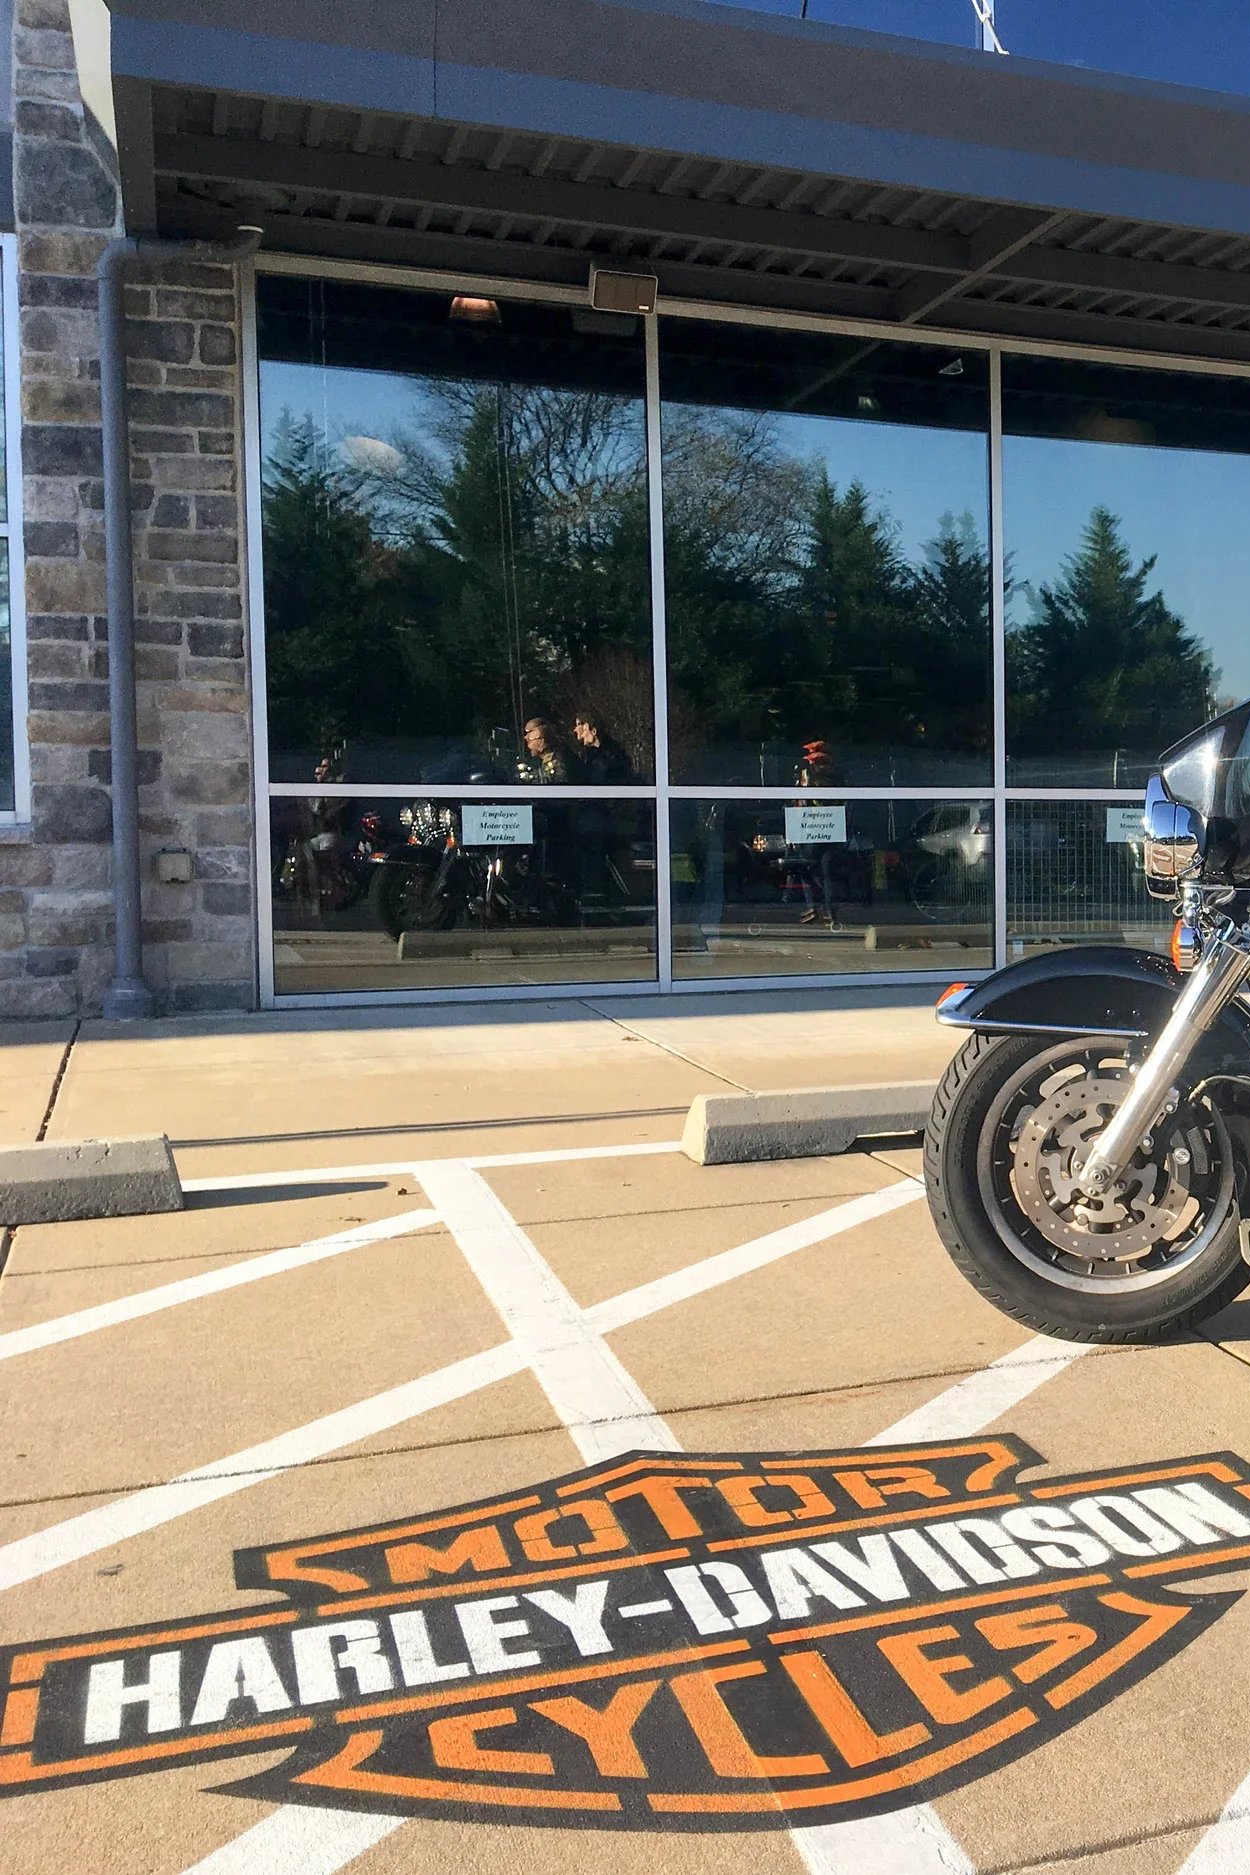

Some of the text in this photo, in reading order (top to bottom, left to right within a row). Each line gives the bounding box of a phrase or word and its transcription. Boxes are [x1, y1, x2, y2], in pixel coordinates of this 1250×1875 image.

[482, 810, 518, 818] Employee
[802, 811, 833, 819] Employee
[480, 822, 520, 830] Motorcycle
[801, 822, 835, 830] Motorcycle
[486, 833, 516, 842] Parking
[806, 832, 832, 840] Parking
[384, 1467, 952, 1584] MOTOR
[428, 1603, 1098, 1779] CYCLES
